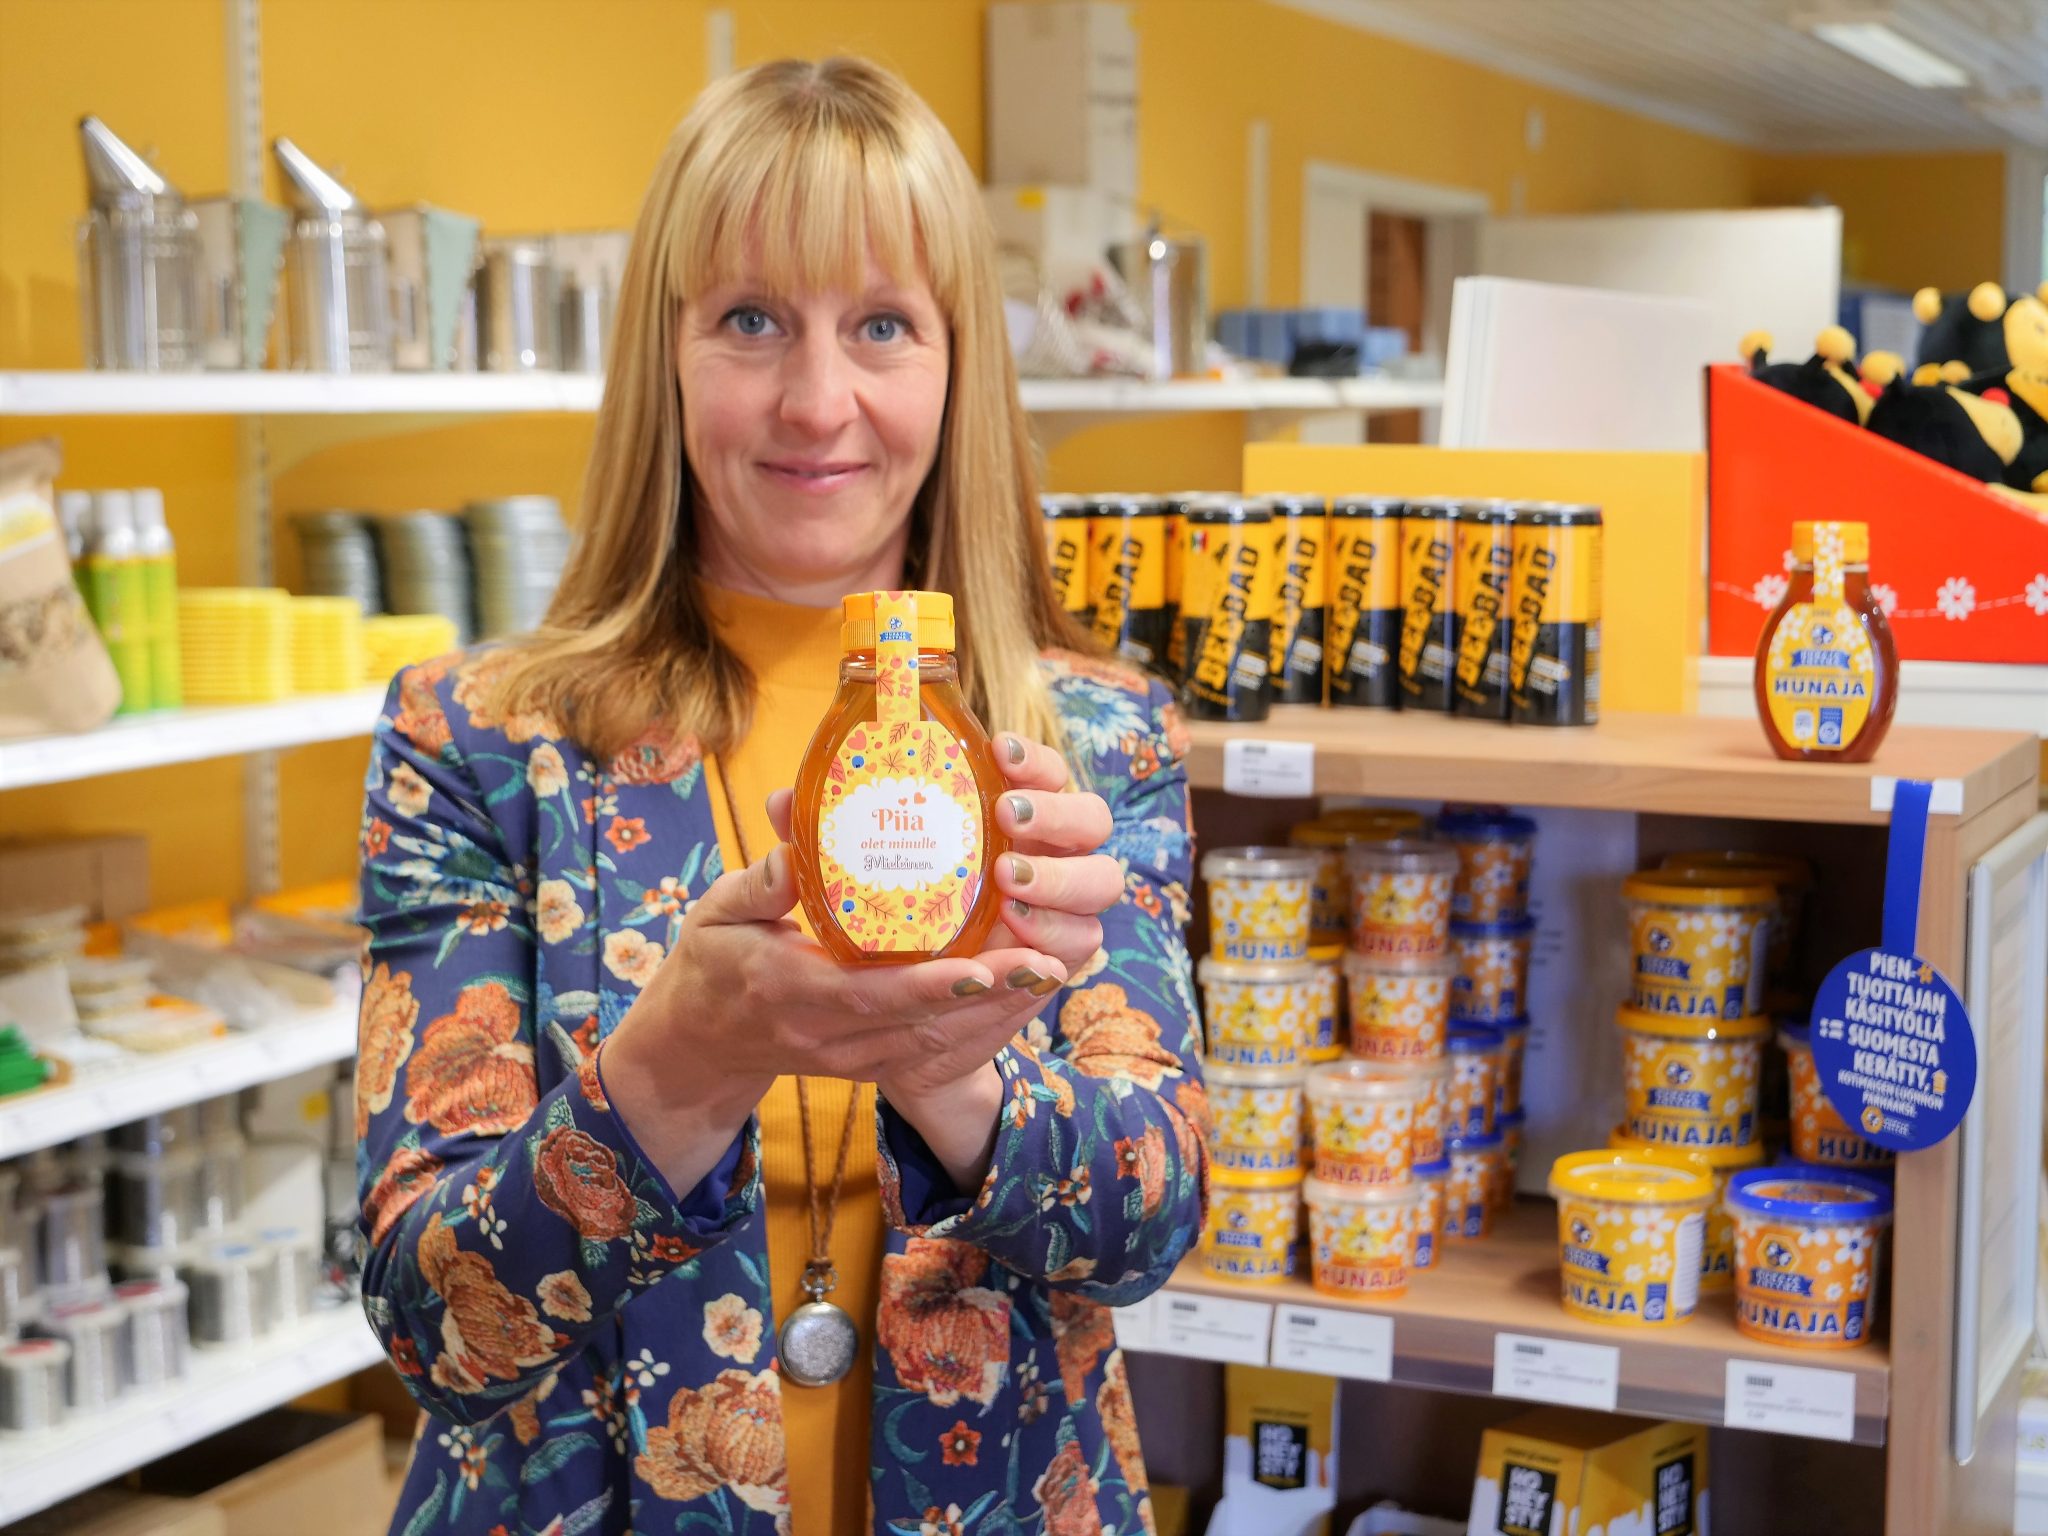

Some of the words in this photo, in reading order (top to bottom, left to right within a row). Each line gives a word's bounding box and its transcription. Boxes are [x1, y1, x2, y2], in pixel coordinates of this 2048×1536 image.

[1775, 679, 1866, 695] HUNAJA
[871, 808, 924, 832] Piia
[860, 837, 887, 850] olet
[888, 836, 937, 850] minulle
[1846, 971, 1947, 1015] TUOTTAJAN
[1847, 1024, 1940, 1068] SUOMESTA
